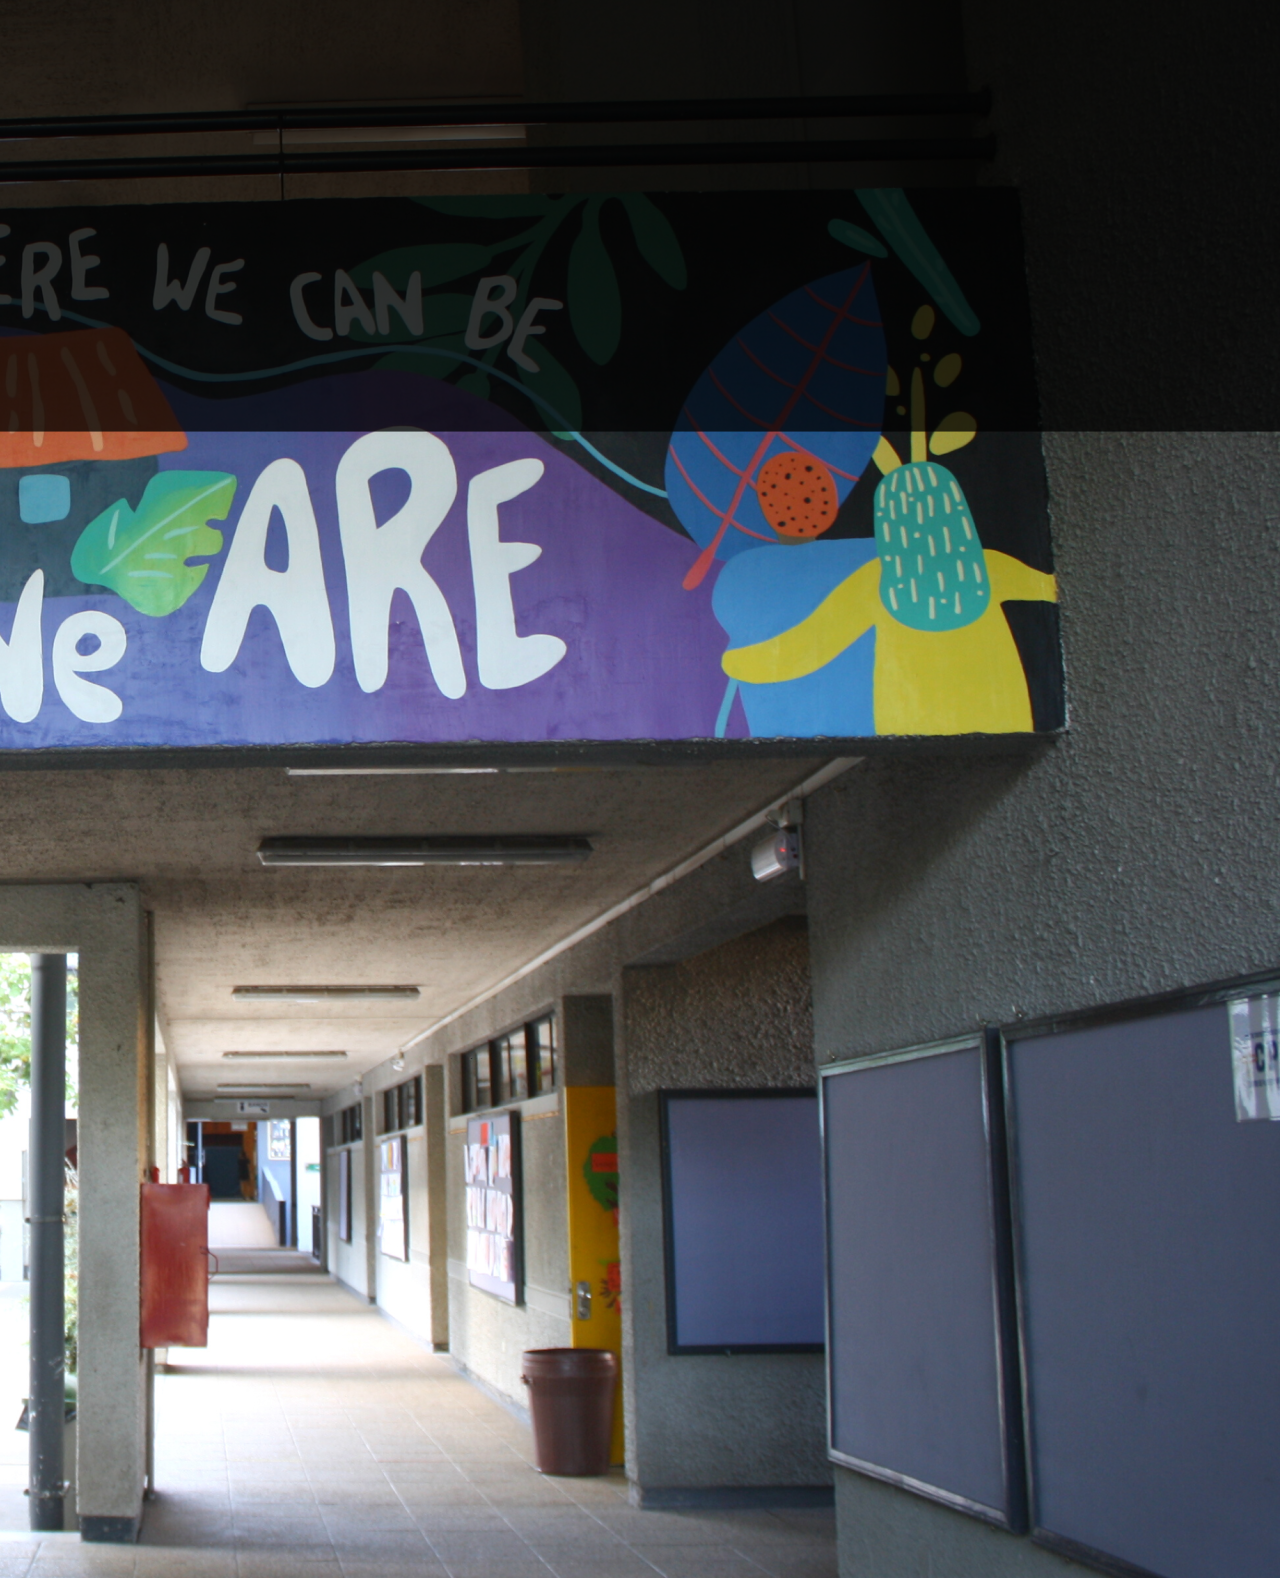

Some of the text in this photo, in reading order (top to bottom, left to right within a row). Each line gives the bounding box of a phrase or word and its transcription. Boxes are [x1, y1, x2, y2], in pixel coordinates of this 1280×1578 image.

[152, 242, 246, 326] WE
[289, 269, 424, 342] CAN
[464, 275, 563, 373] BE
[200, 427, 568, 700] ARE
